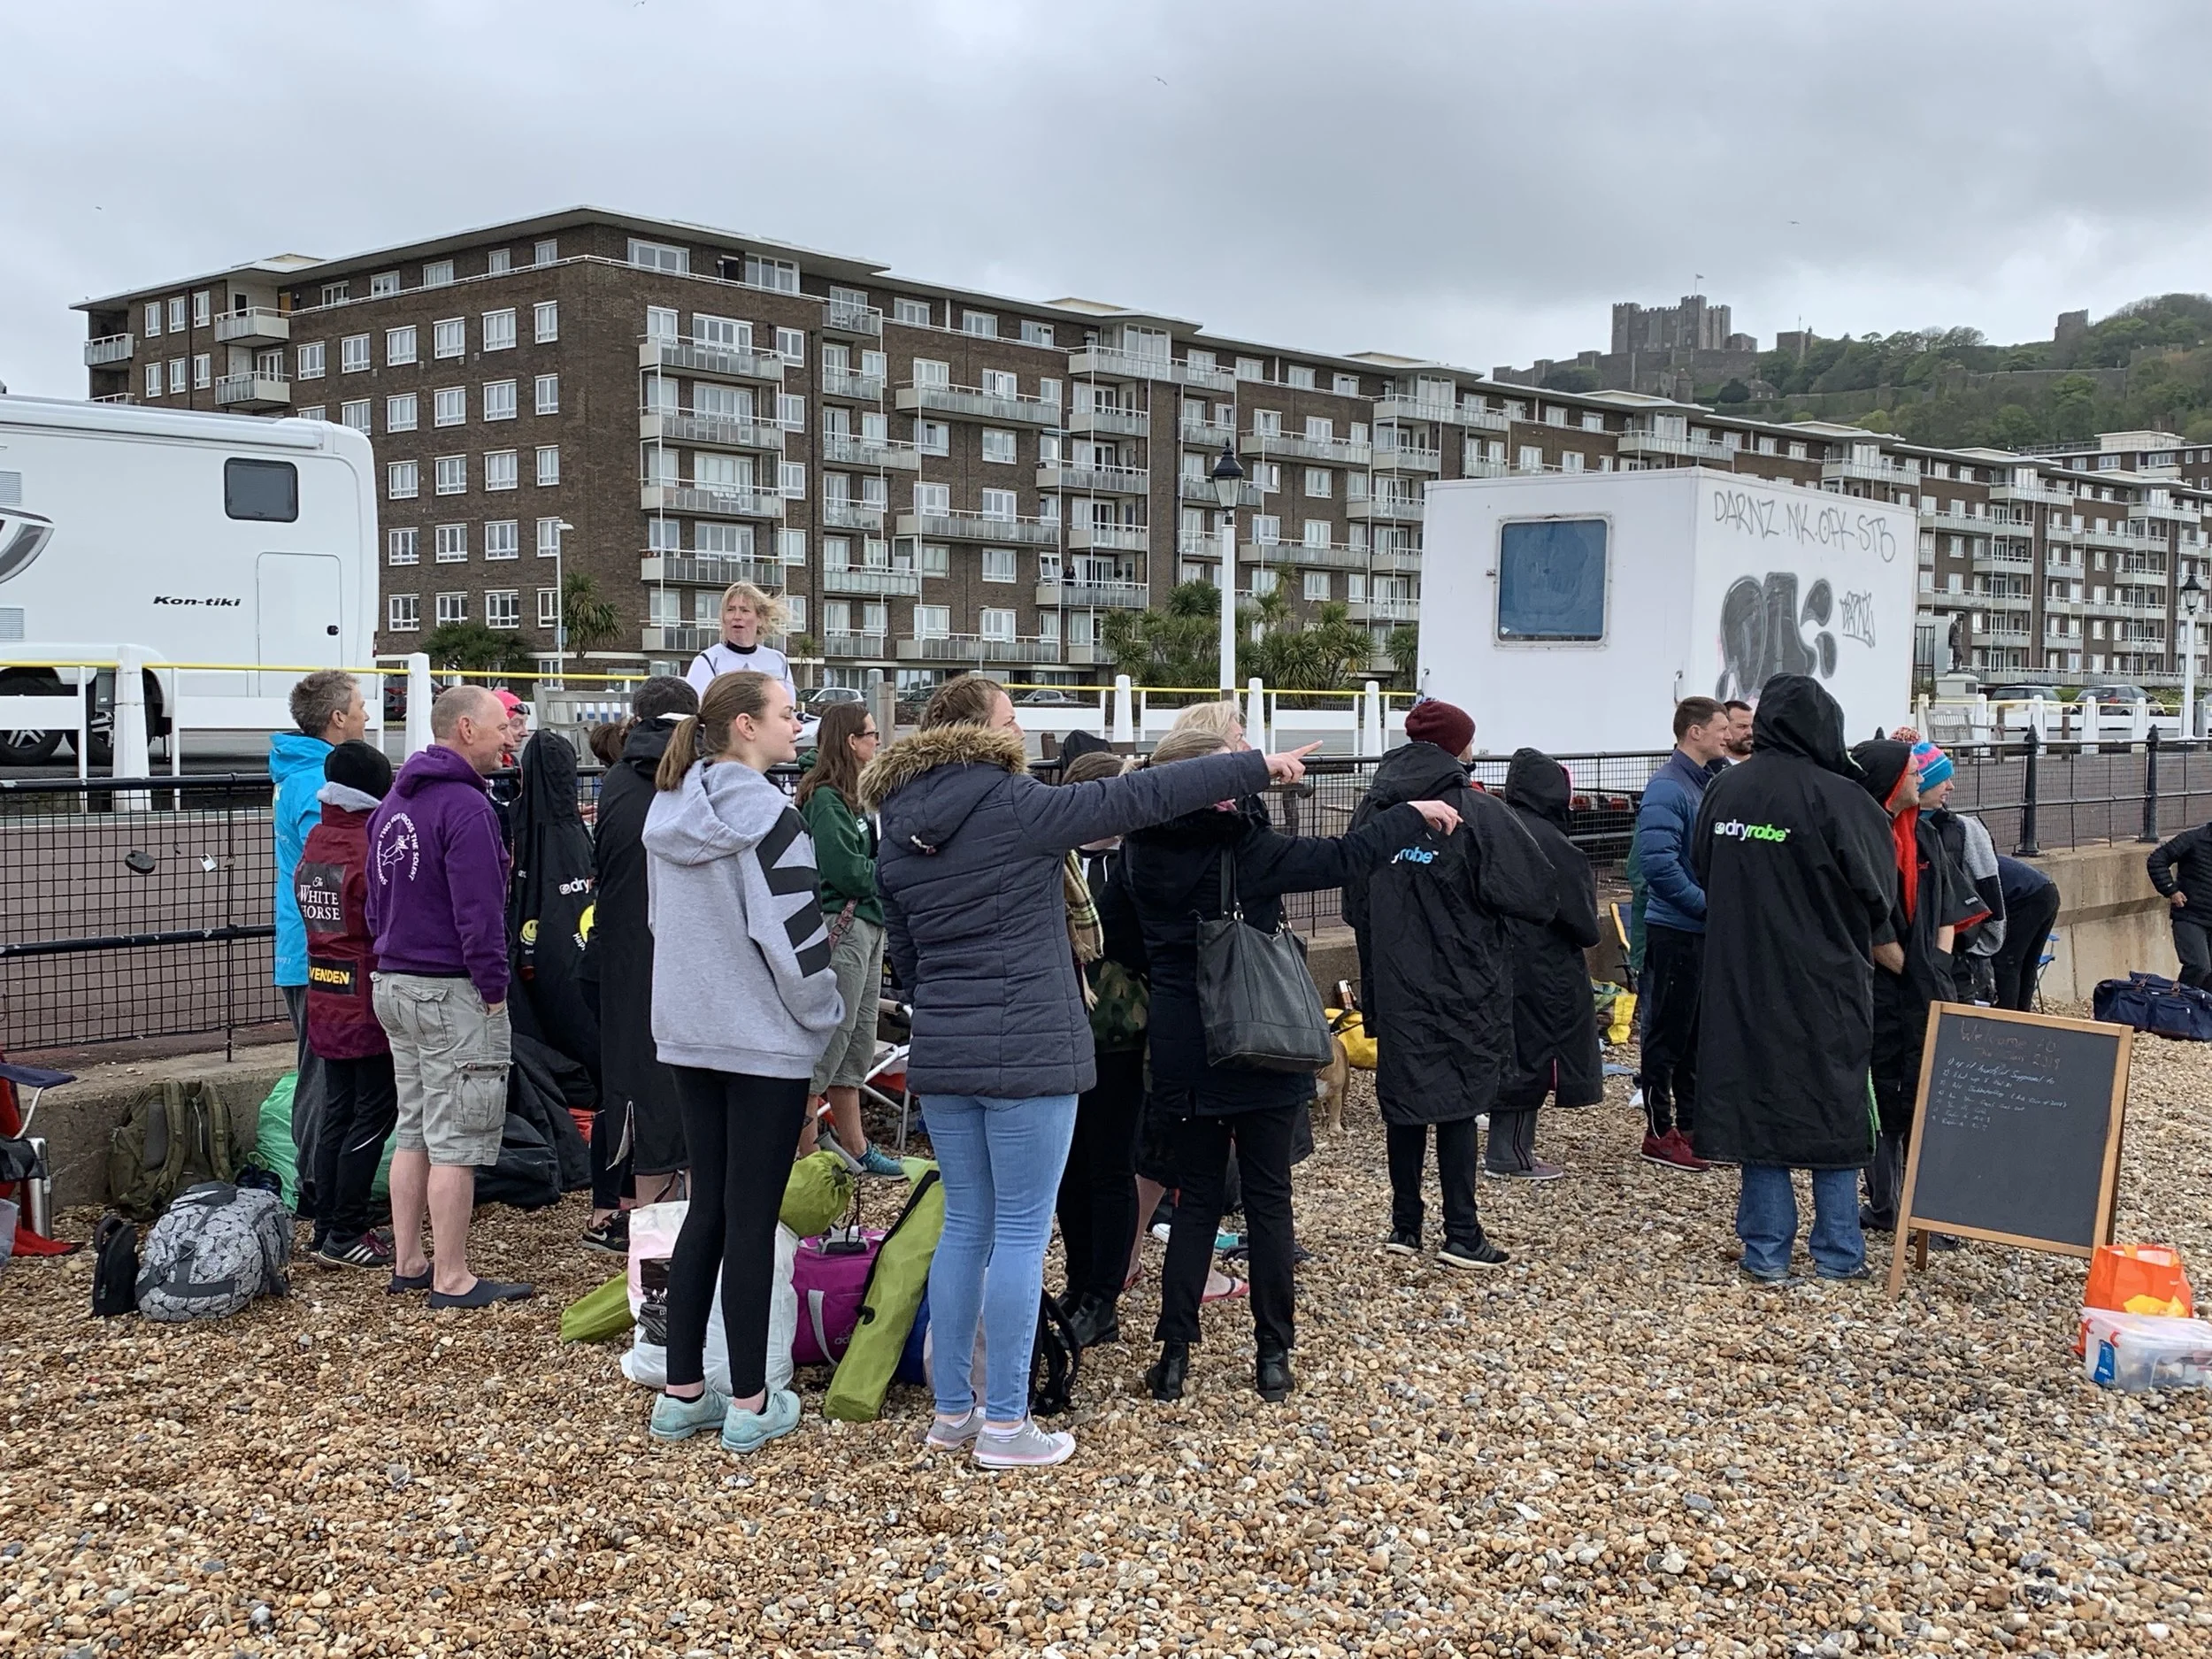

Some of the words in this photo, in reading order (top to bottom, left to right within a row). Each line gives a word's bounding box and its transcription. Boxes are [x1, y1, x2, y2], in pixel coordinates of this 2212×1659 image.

[153, 596, 241, 607] Kon-tiki
[1725, 818, 1787, 842] dryrobe
[411, 833, 419, 850] THE
[300, 885, 340, 905] WHITE
